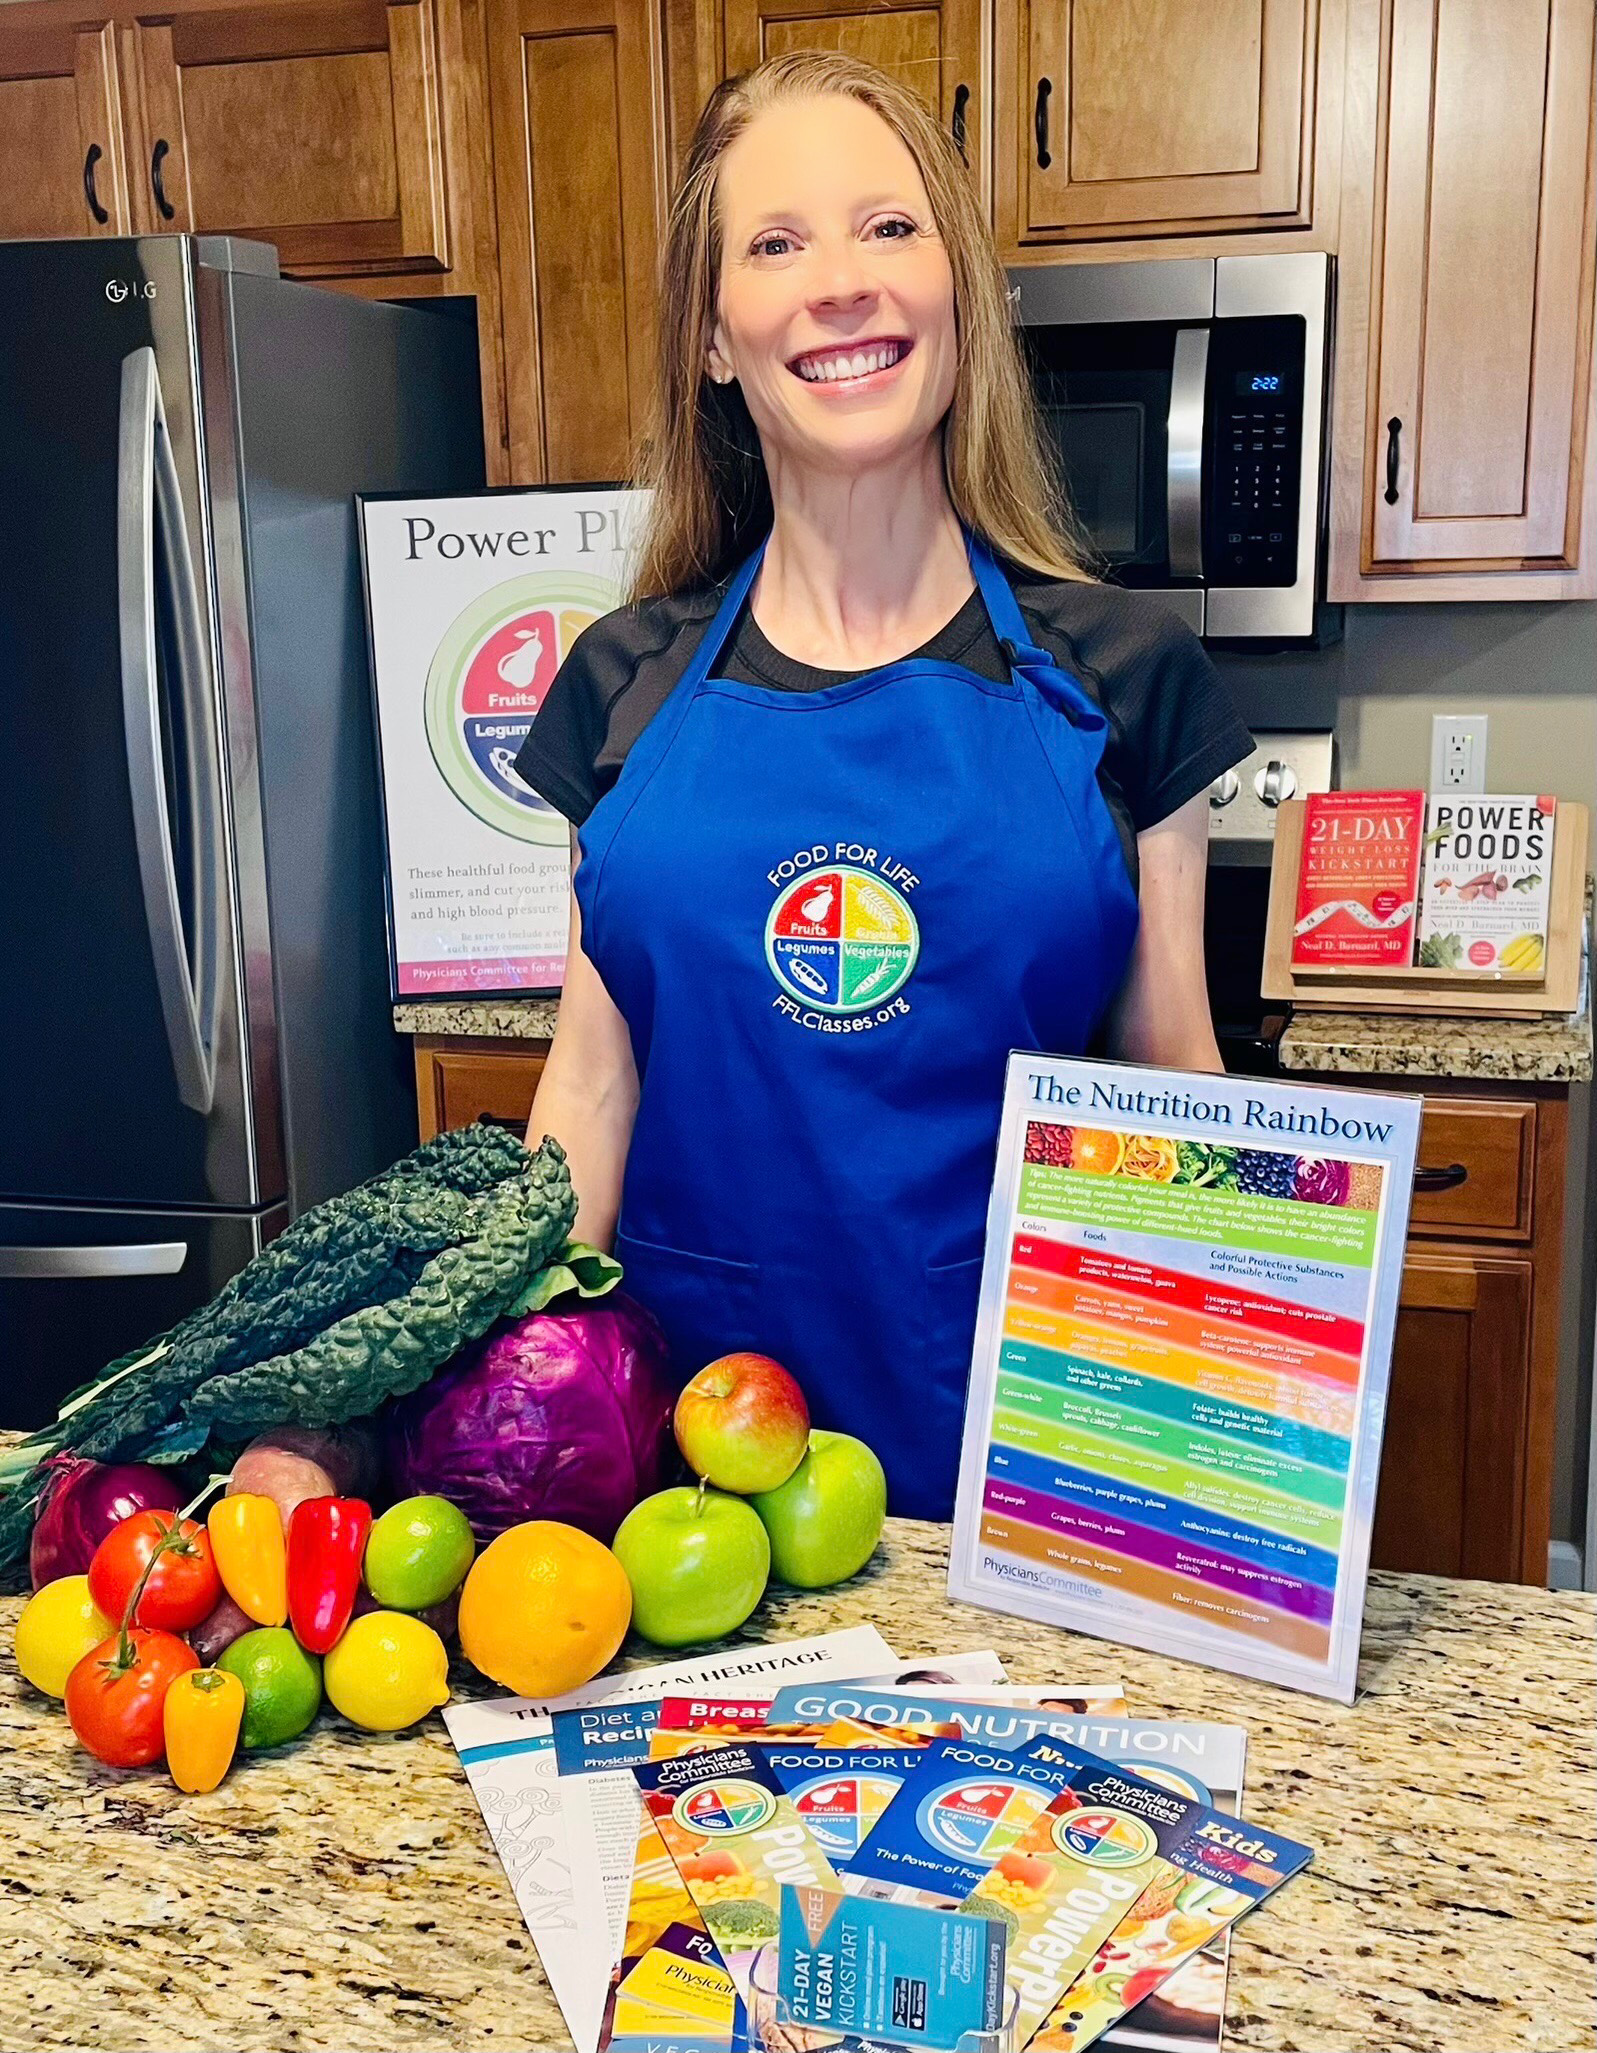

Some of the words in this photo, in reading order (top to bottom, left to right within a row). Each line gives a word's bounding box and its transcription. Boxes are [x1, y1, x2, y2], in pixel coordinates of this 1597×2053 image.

[402, 517, 556, 560] Power
[488, 692, 537, 707] Fruits
[475, 724, 531, 740] Legum
[1311, 816, 1413, 842] 21-DAY
[1437, 806, 1545, 831] POWER
[1309, 845, 1366, 855] WEIGHT
[1375, 844, 1410, 854] LOSS
[1435, 833, 1544, 861] FOODS
[408, 867, 443, 880] These
[447, 863, 505, 878] healthful
[509, 862, 535, 875] food
[539, 863, 567, 877] grou
[767, 845, 829, 887] FOOD
[835, 842, 878, 867] FOR
[879, 856, 920, 893] LIFE
[1308, 858, 1410, 870] KICKSTART
[1433, 863, 1459, 872] FOR
[1500, 864, 1542, 873] BRAIN
[409, 887, 464, 900] slimmer,
[467, 885, 490, 897] and
[494, 886, 513, 896] cut
[517, 885, 545, 899] your
[410, 907, 434, 920] and
[438, 906, 466, 921] high
[469, 905, 503, 918] blood
[507, 905, 563, 920] pressure.
[790, 922, 828, 936] Fruits
[777, 940, 835, 955] Legumes
[845, 944, 910, 960] Vegetables
[1383, 940, 1402, 951] MD
[413, 965, 468, 981] Physicians
[470, 963, 529, 977] Committee
[531, 962, 547, 973] for
[772, 994, 911, 1033] FFLClasses.org
[1026, 1074, 1082, 1105] The
[1087, 1081, 1233, 1124] Nutrition
[1241, 1098, 1394, 1143] Rainbow
[1021, 1220, 1047, 1232] Colors
[1083, 1230, 1107, 1241] Foods
[1209, 1261, 1225, 1272] and
[1227, 1263, 1262, 1278] Possible
[1264, 1269, 1297, 1283] Actions
[1210, 1249, 1246, 1263] Colorful
[1248, 1255, 1292, 1271] Protective
[1294, 1262, 1344, 1279] Substances
[1006, 1351, 1026, 1362] Green
[1066, 1373, 1079, 1383] and
[1080, 1376, 1098, 1387] other
[1099, 1380, 1121, 1393] greens
[1067, 1364, 1095, 1378] Spinach,
[1096, 1370, 1112, 1381] kale,
[1114, 1373, 1143, 1387] collards,
[1191, 1412, 1207, 1422] cells
[1209, 1415, 1223, 1425] and
[1224, 1419, 1250, 1432] genetic
[1252, 1424, 1283, 1437] material
[1192, 1402, 1216, 1415] Folate:
[1218, 1407, 1239, 1419] builds
[1241, 1412, 1269, 1426] healthy
[994, 1455, 1008, 1465] Blue
[990, 1490, 1026, 1507] Red-purple
[1054, 1477, 1093, 1493] Blueberries,
[1095, 1486, 1117, 1500] purple
[1118, 1493, 1143, 1506] grapes,
[1144, 1497, 1166, 1511] plums
[986, 1526, 1008, 1538] Brown
[1050, 1511, 1076, 1526] Grapes,
[1078, 1518, 1103, 1531] berries,
[1104, 1524, 1125, 1537] plums
[1180, 1519, 1231, 1540] Anthocyanins:
[1232, 1531, 1259, 1546] destroy
[1261, 1537, 1275, 1548] free
[1277, 1541, 1307, 1555] radicals
[1046, 1548, 1069, 1560] Whole
[1069, 1554, 1092, 1568] grains,
[1094, 1559, 1122, 1575] legumes
[1175, 1561, 1202, 1576] activity
[1176, 1551, 1219, 1568] Resveratrol:
[1219, 1564, 1235, 1574] may
[1236, 1568, 1268, 1583] suppress
[1269, 1574, 1302, 1590] estrogen
[1171, 1592, 1192, 1604] Fiber:
[1193, 1599, 1224, 1612] removes
[1225, 1605, 1269, 1625] carcinogens
[701, 1648, 833, 1682] HERITAGE
[509, 1705, 549, 1721] TH
[580, 1711, 634, 1729] Diet
[689, 1703, 770, 1719] Breas
[582, 1726, 652, 1745] Recip
[794, 1696, 932, 1725] GOOD
[949, 1711, 1207, 1756] NUTRITION
[584, 1753, 649, 1768] Physicians
[657, 1757, 752, 1784] Committee
[662, 1748, 748, 1774] Physicians
[769, 1755, 844, 1768] FOOD
[849, 1756, 898, 1768] FOR
[941, 1746, 1015, 1772] FOOD
[1016, 1764, 1065, 1787] FOR
[588, 1775, 631, 1785] Diabetes
[1088, 1782, 1181, 1822] Committee
[1102, 1776, 1187, 1814] Physicians
[803, 1815, 851, 1824] Legumes
[812, 1804, 845, 1813] Fruits
[940, 1810, 988, 1826] Legumes
[956, 1801, 988, 1815] Fruits
[1194, 1820, 1279, 1864] Kids
[876, 1847, 898, 1862] The
[901, 1853, 943, 1871] Power
[943, 1864, 959, 1876] of
[959, 1867, 984, 1881] Foo
[1188, 1858, 1235, 1885] Health
[808, 1889, 824, 1932] FREE
[685, 1935, 713, 1955] Fo
[951, 1924, 962, 1976] Physicians
[1007, 1867, 1139, 2015] PowerPl
[961, 1926, 973, 1984] Committee
[665, 1964, 736, 1994] Physicia
[792, 1949, 811, 2019] 21-DAY
[838, 1920, 858, 2027] KICKSTART
[815, 1953, 834, 2021] VEGAN
[985, 1943, 1001, 2031] DayKickstart.org
